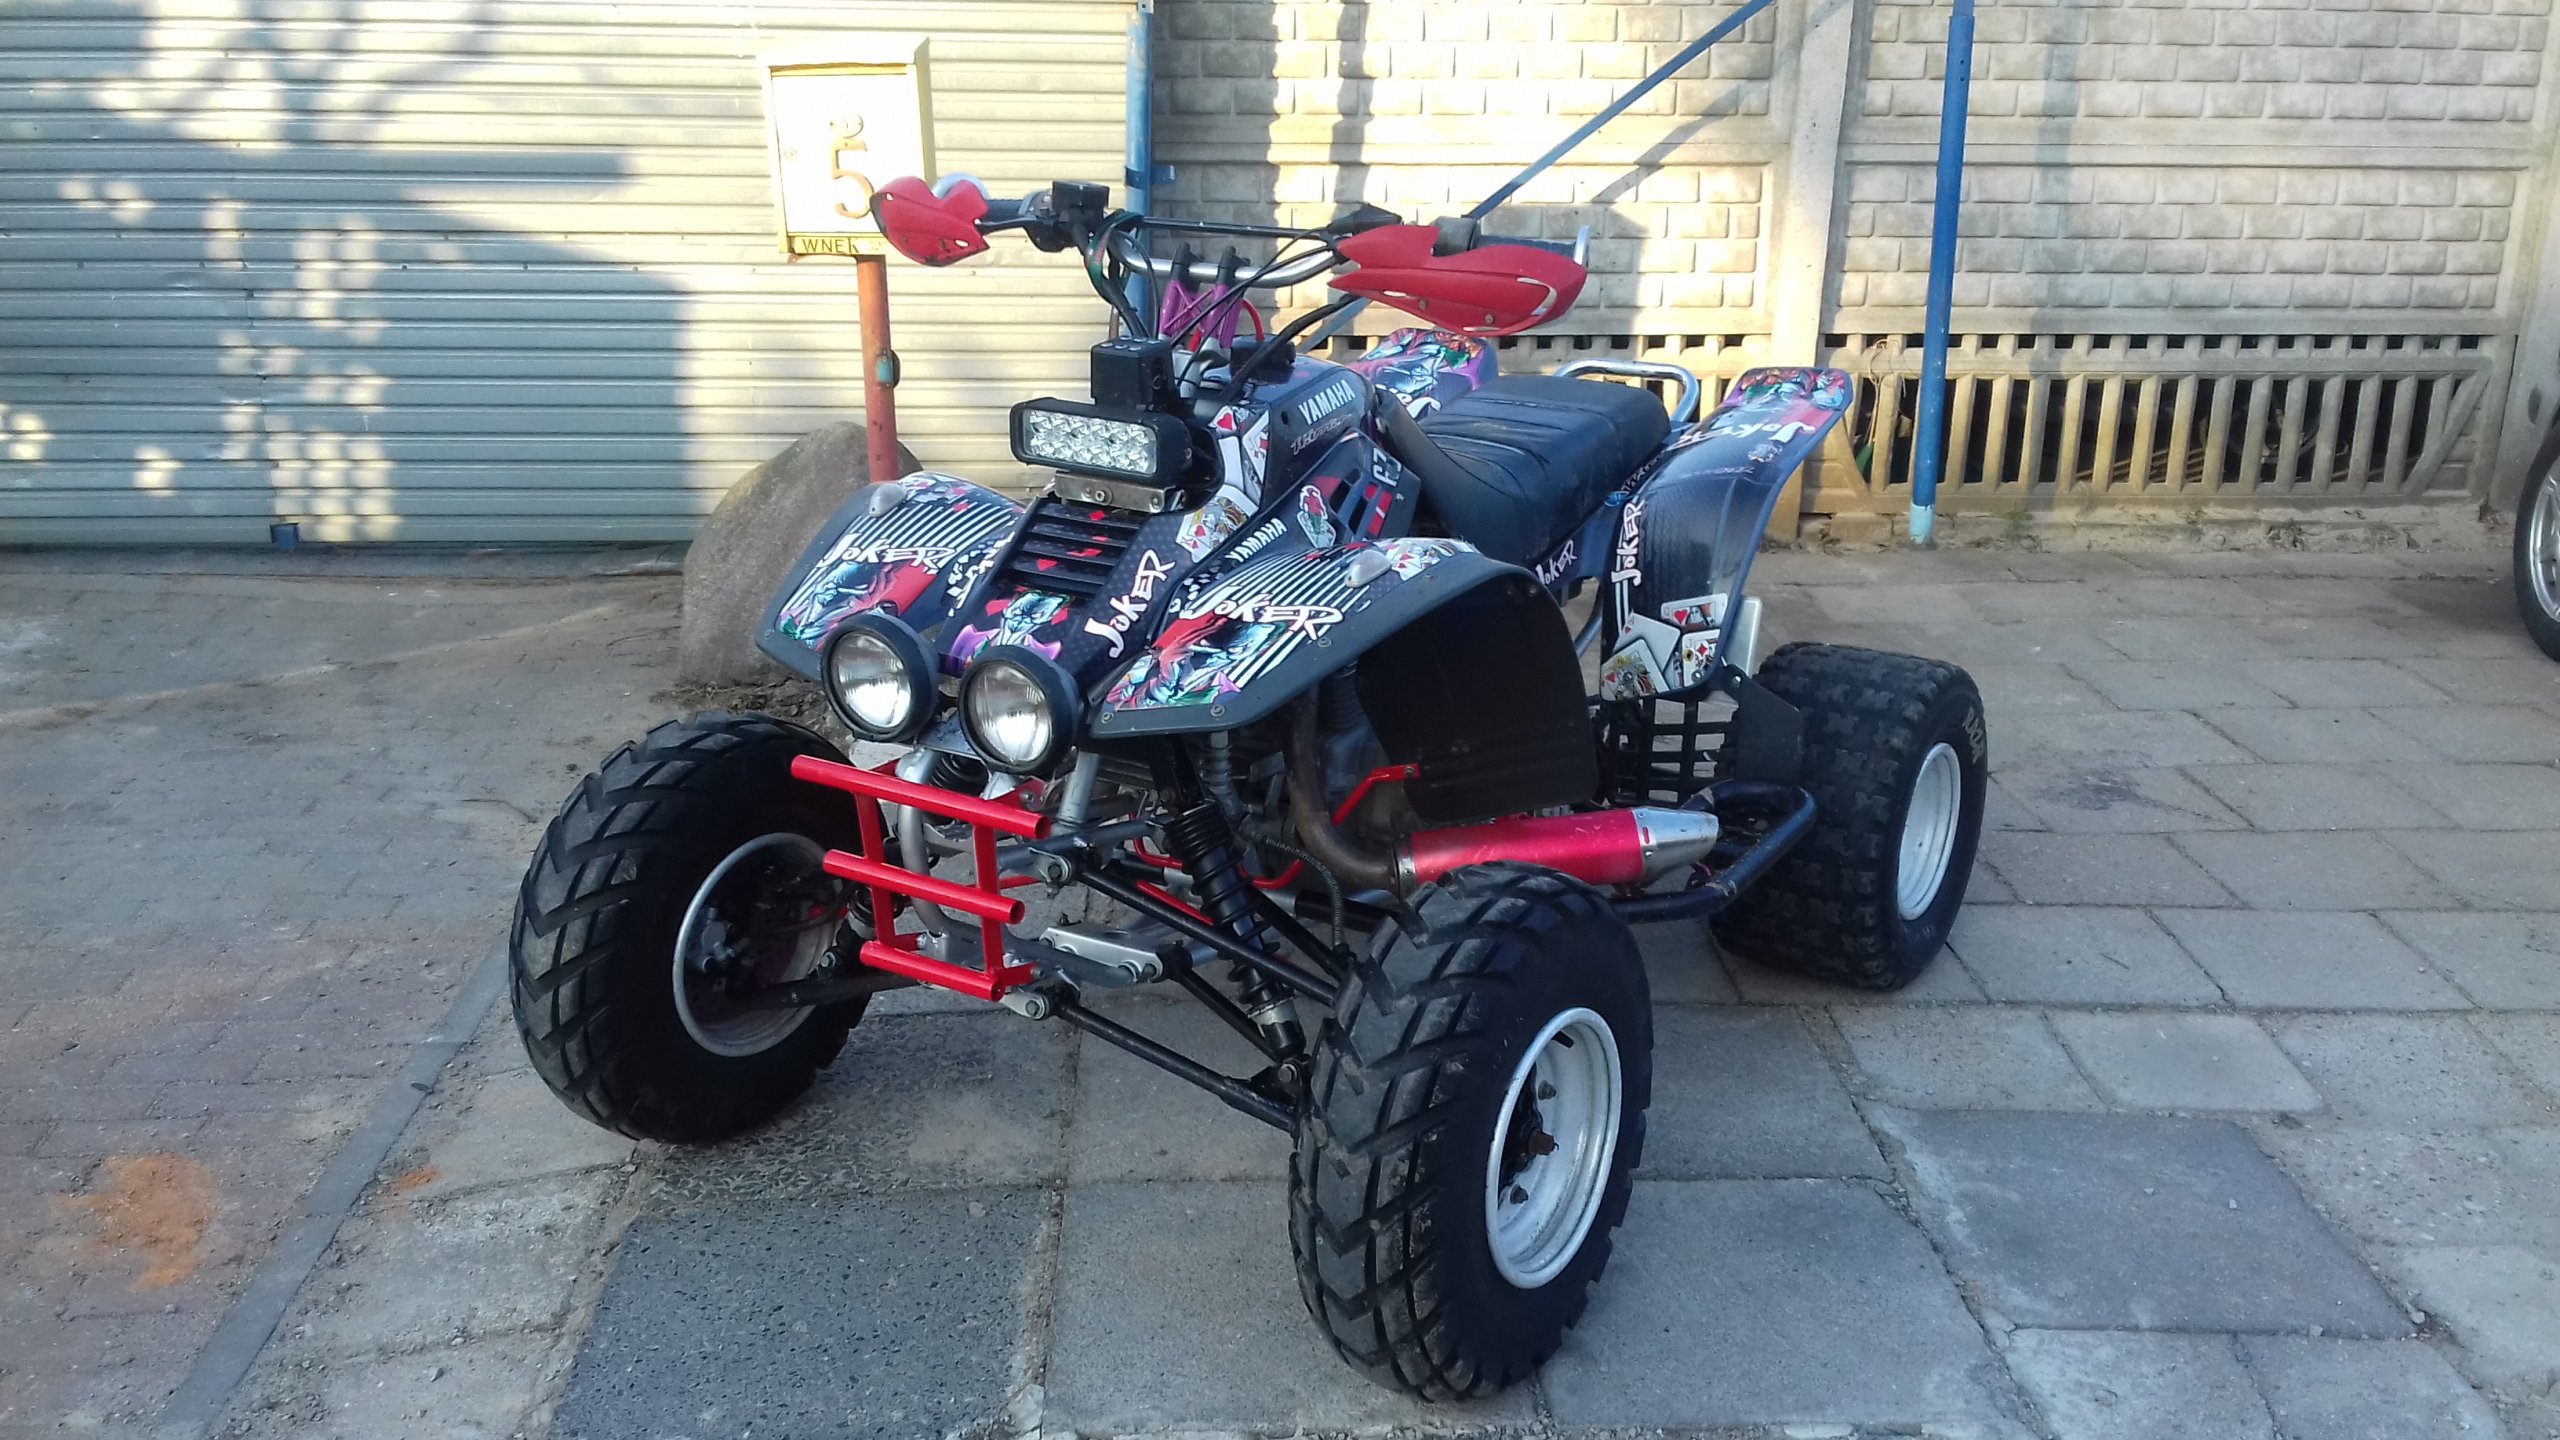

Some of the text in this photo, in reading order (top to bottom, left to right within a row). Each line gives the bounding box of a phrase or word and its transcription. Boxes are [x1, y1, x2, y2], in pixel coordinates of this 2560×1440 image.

[830, 136, 875, 219] 5
[1298, 379, 1356, 425] YAMAHA
[1224, 517, 1288, 563] YAMAHA
